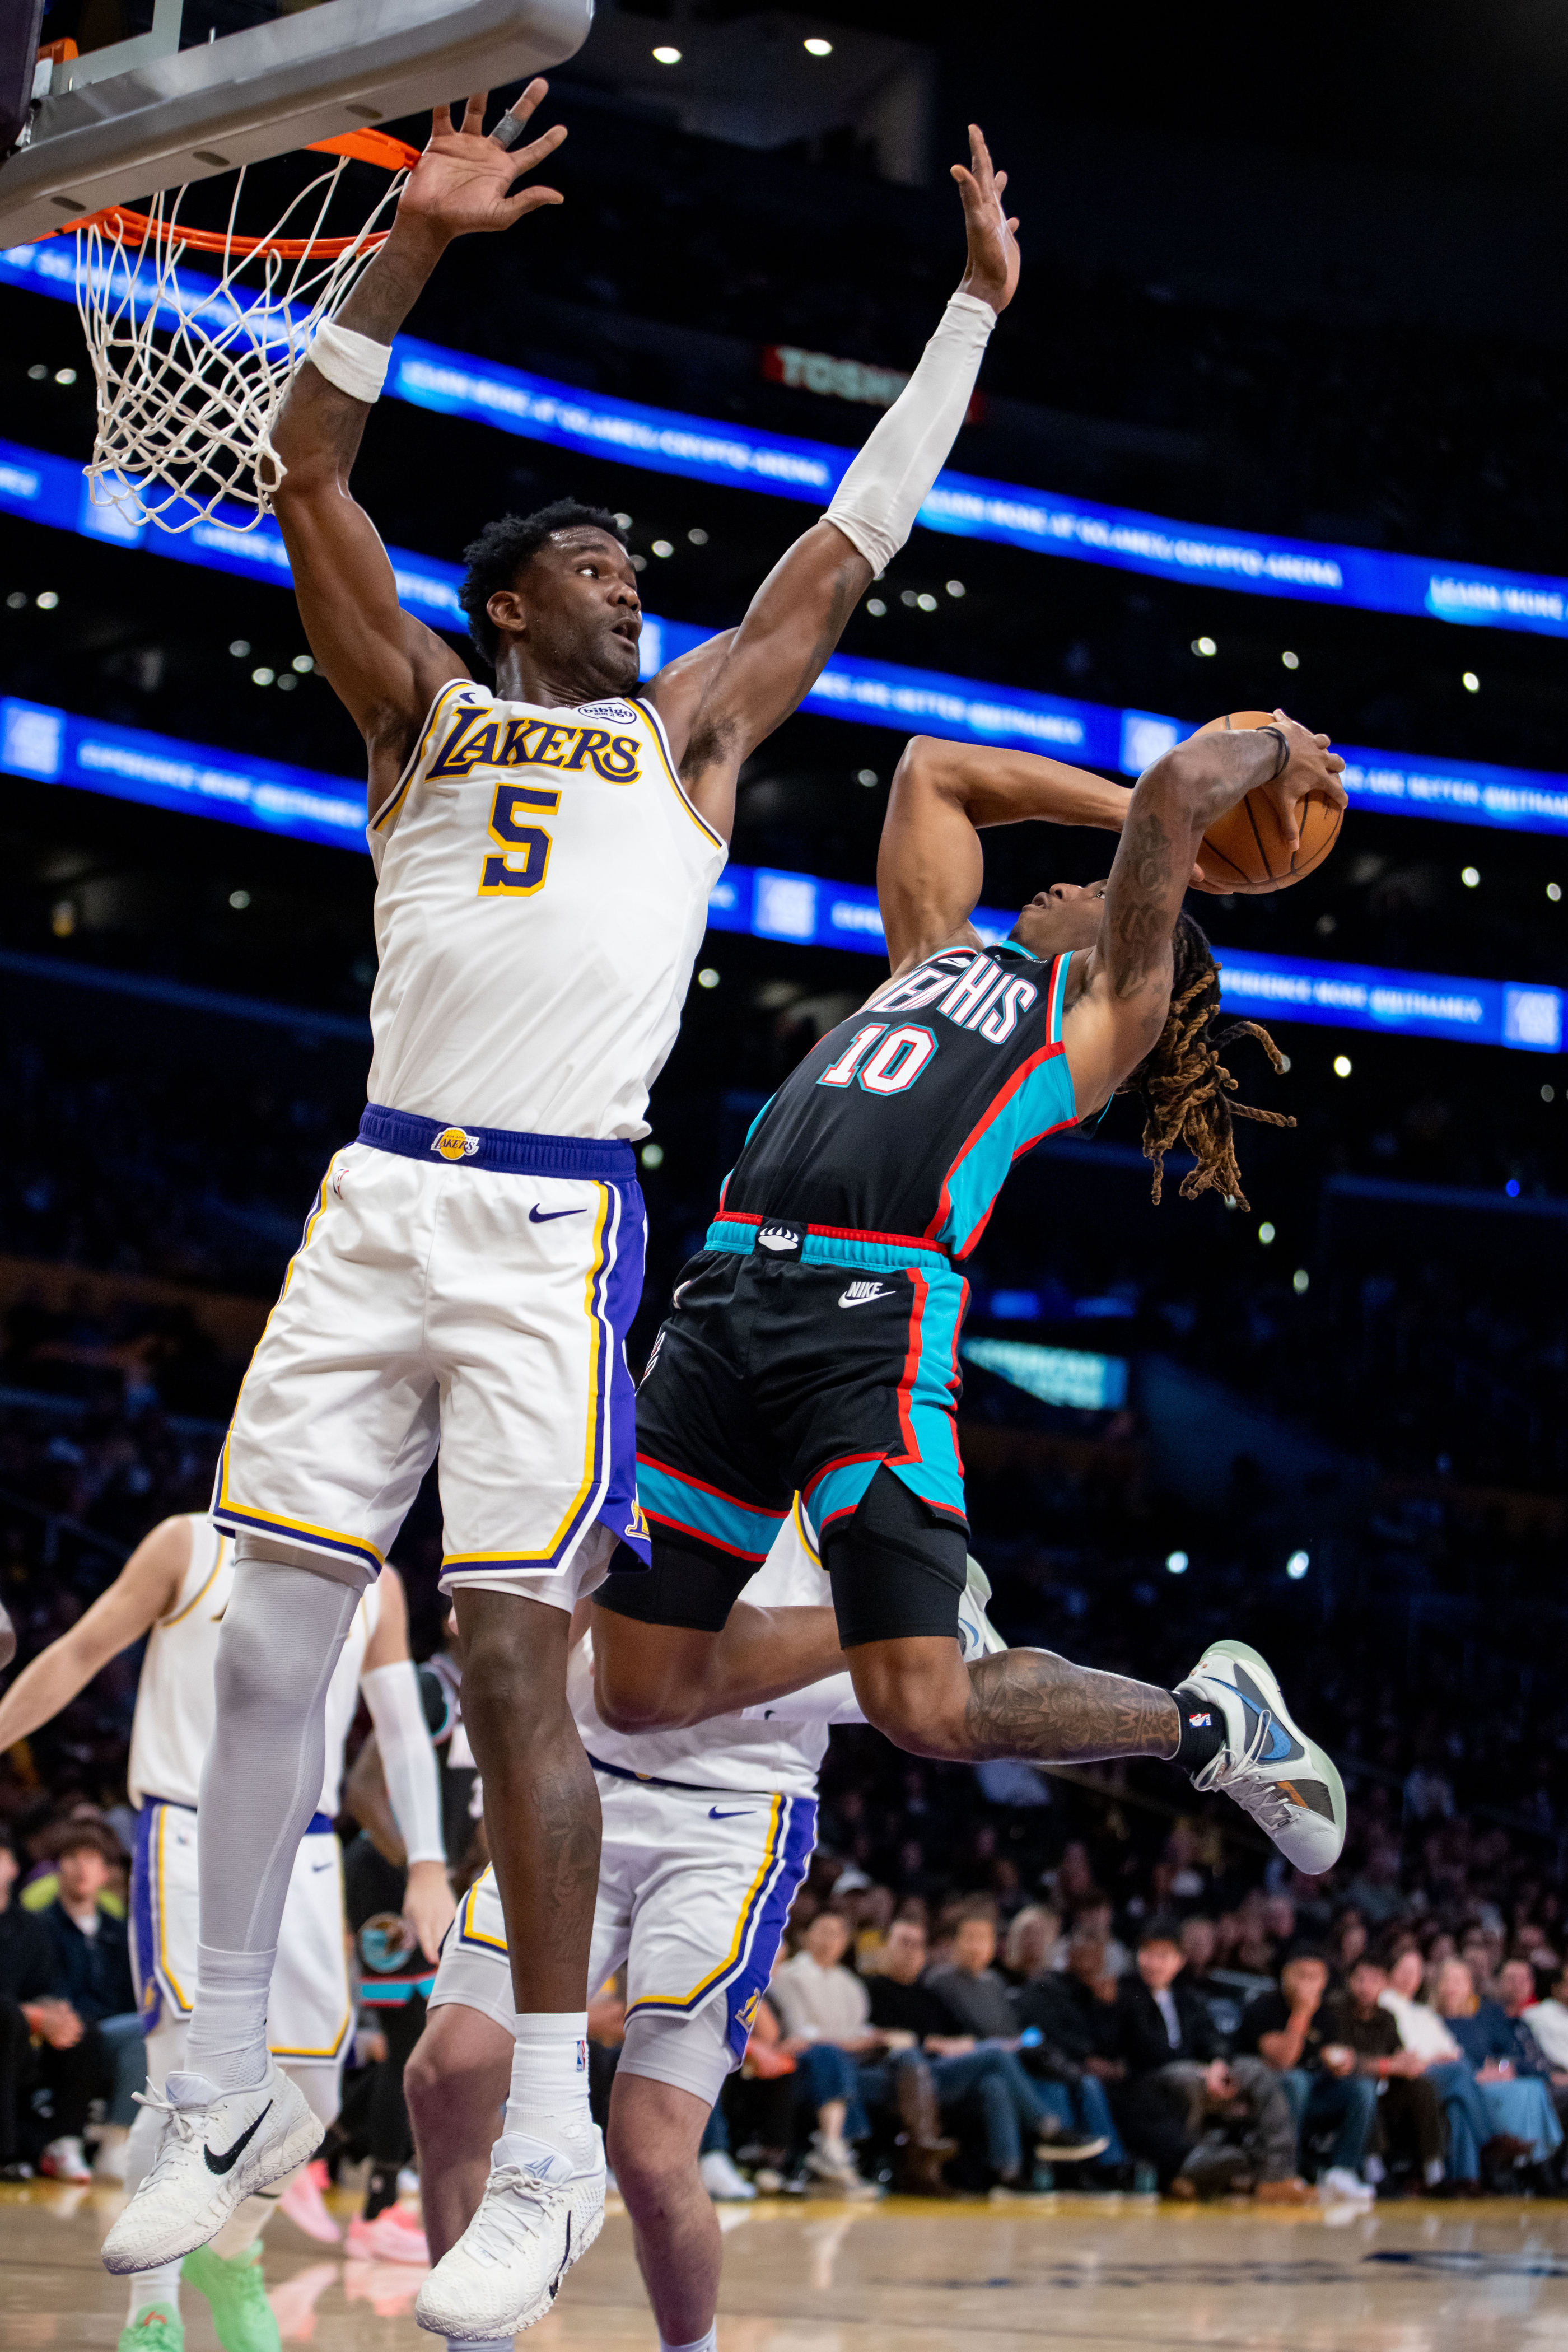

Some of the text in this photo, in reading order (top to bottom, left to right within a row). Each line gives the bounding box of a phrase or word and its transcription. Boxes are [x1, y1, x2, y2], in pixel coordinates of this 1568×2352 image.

[582, 706, 633, 717] bibigo
[424, 706, 642, 786] LAKERS
[477, 782, 562, 897] 5
[816, 1022, 939, 1096] 10
[434, 1134, 477, 1154] LAKERS
[846, 1281, 883, 1298] NIKE
